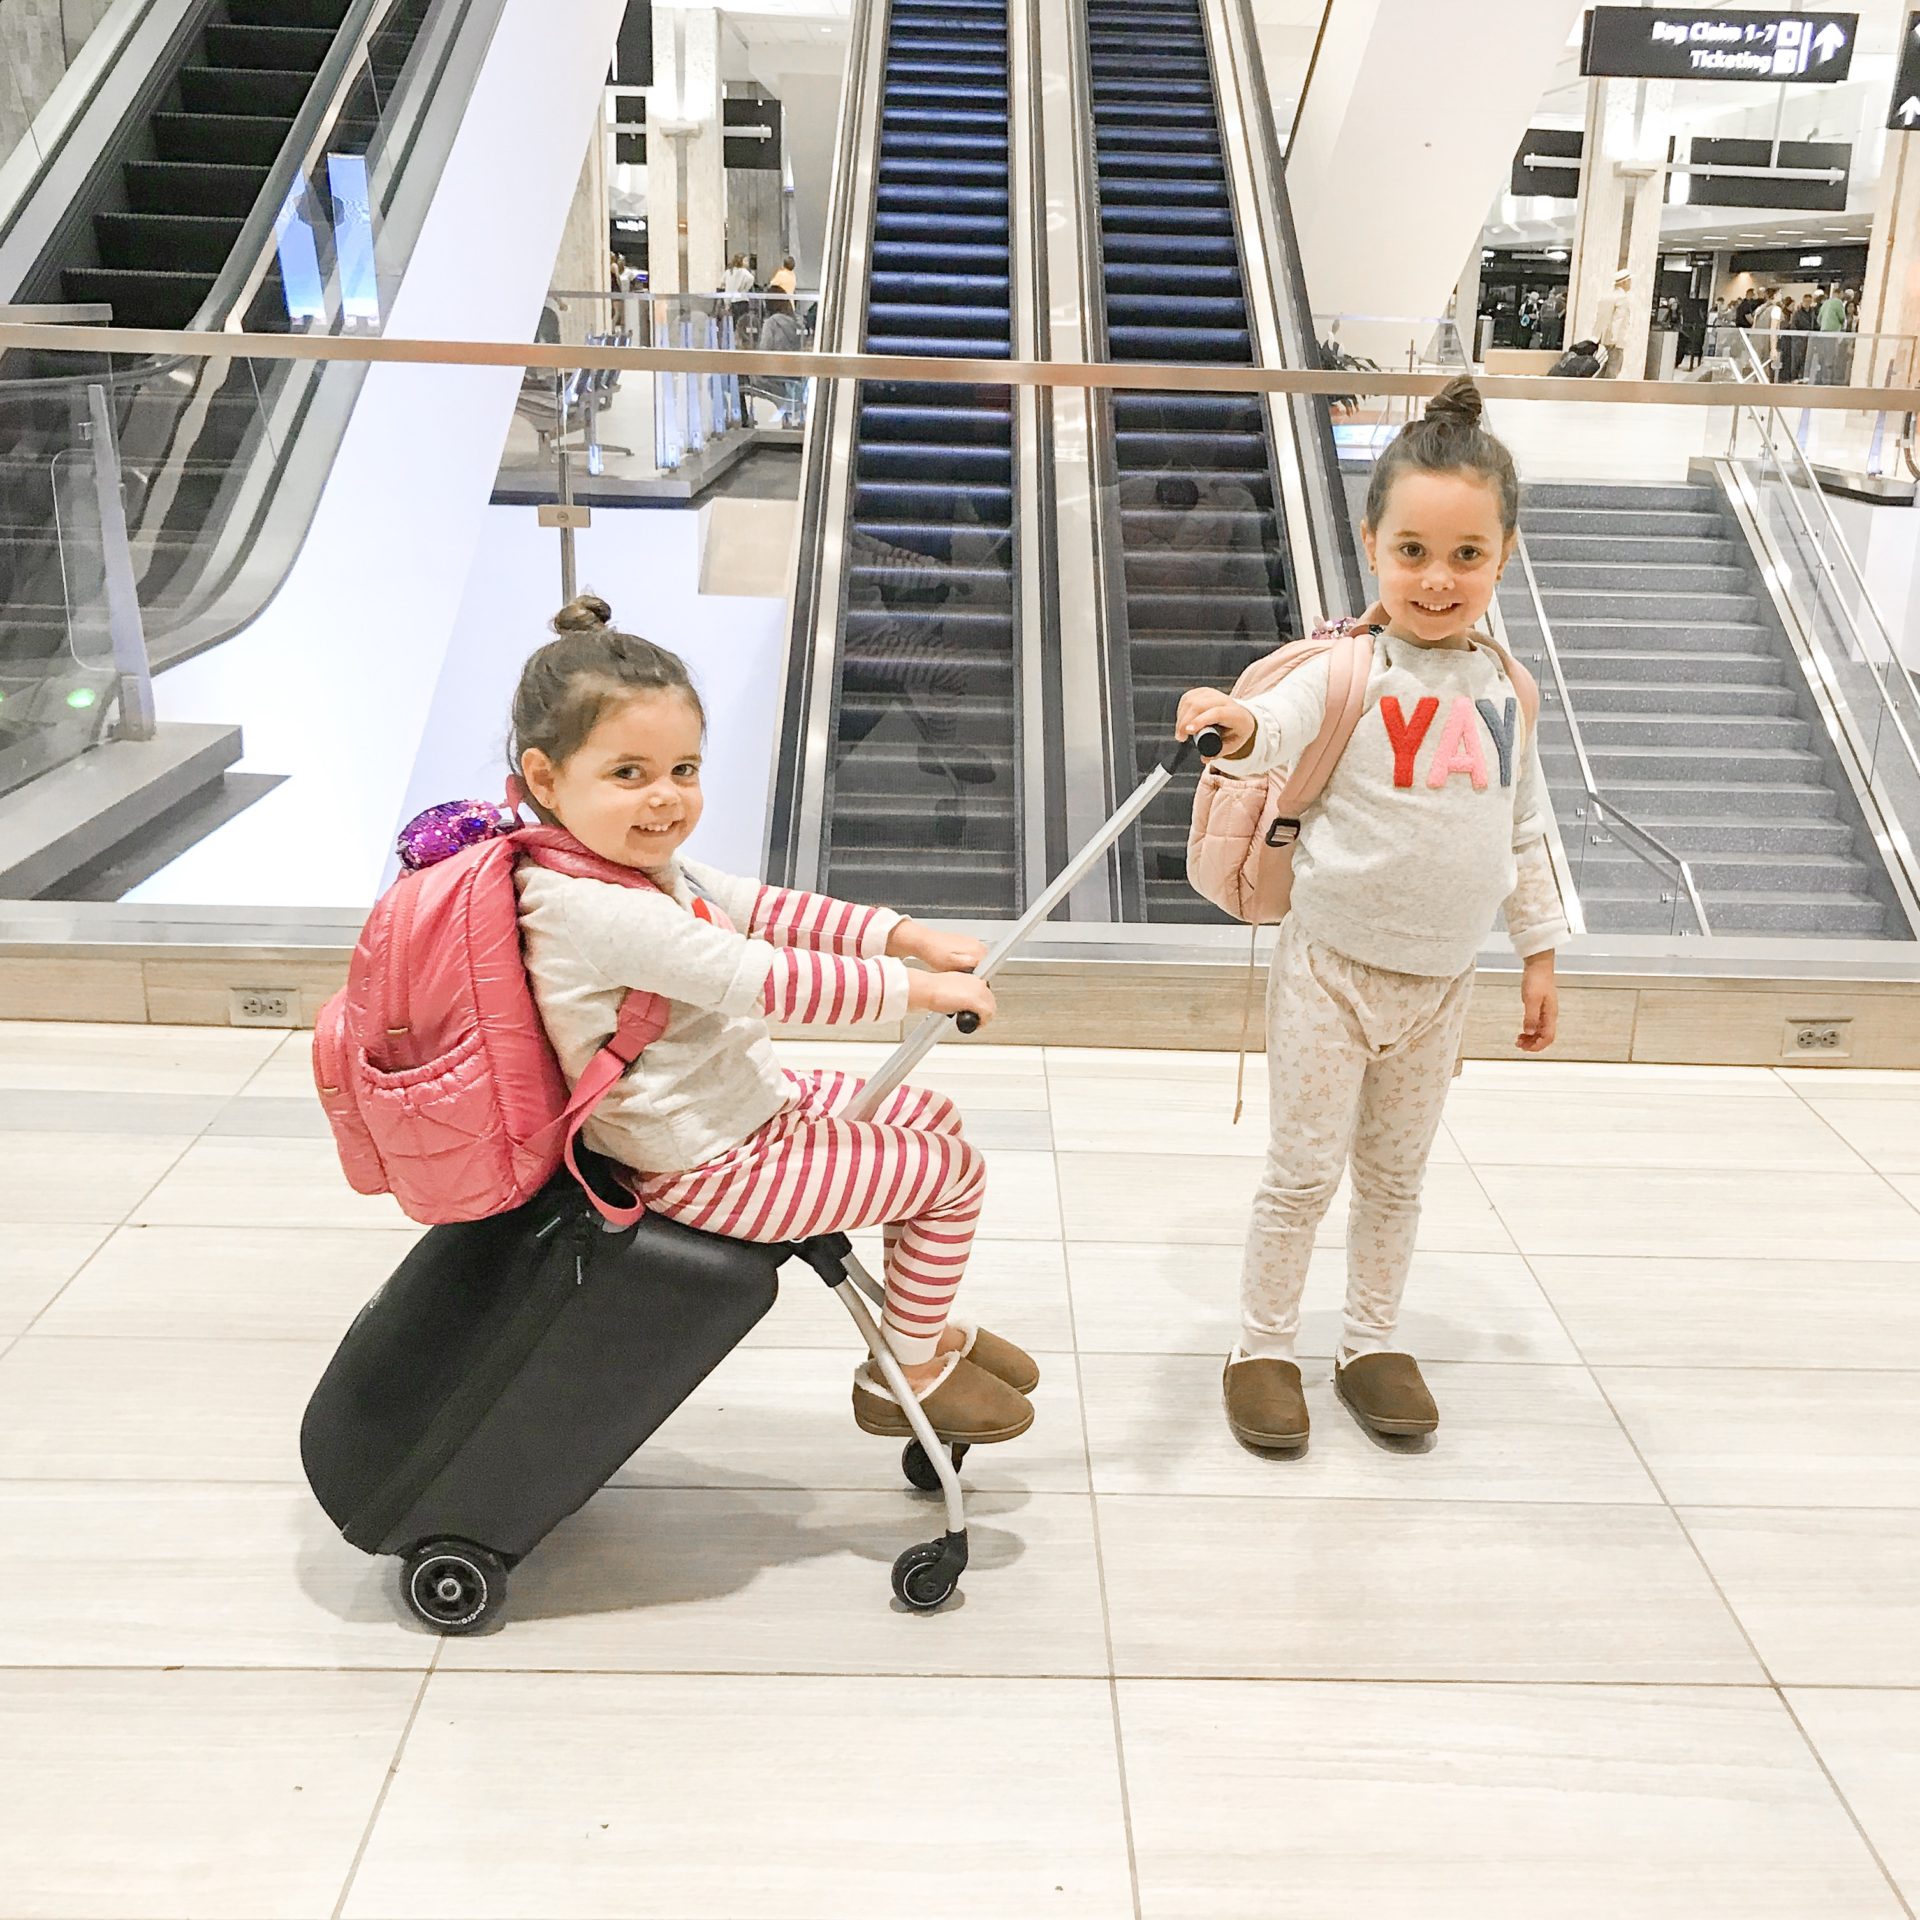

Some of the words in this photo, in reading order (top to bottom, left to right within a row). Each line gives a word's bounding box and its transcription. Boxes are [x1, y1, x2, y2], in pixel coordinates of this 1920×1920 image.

[1652, 21, 1689, 45] Bag
[1690, 22, 1742, 42] Claim
[1744, 23, 1777, 44] 1-7
[1690, 50, 1773, 74] Ticketing
[1380, 695, 1517, 789] YAY
